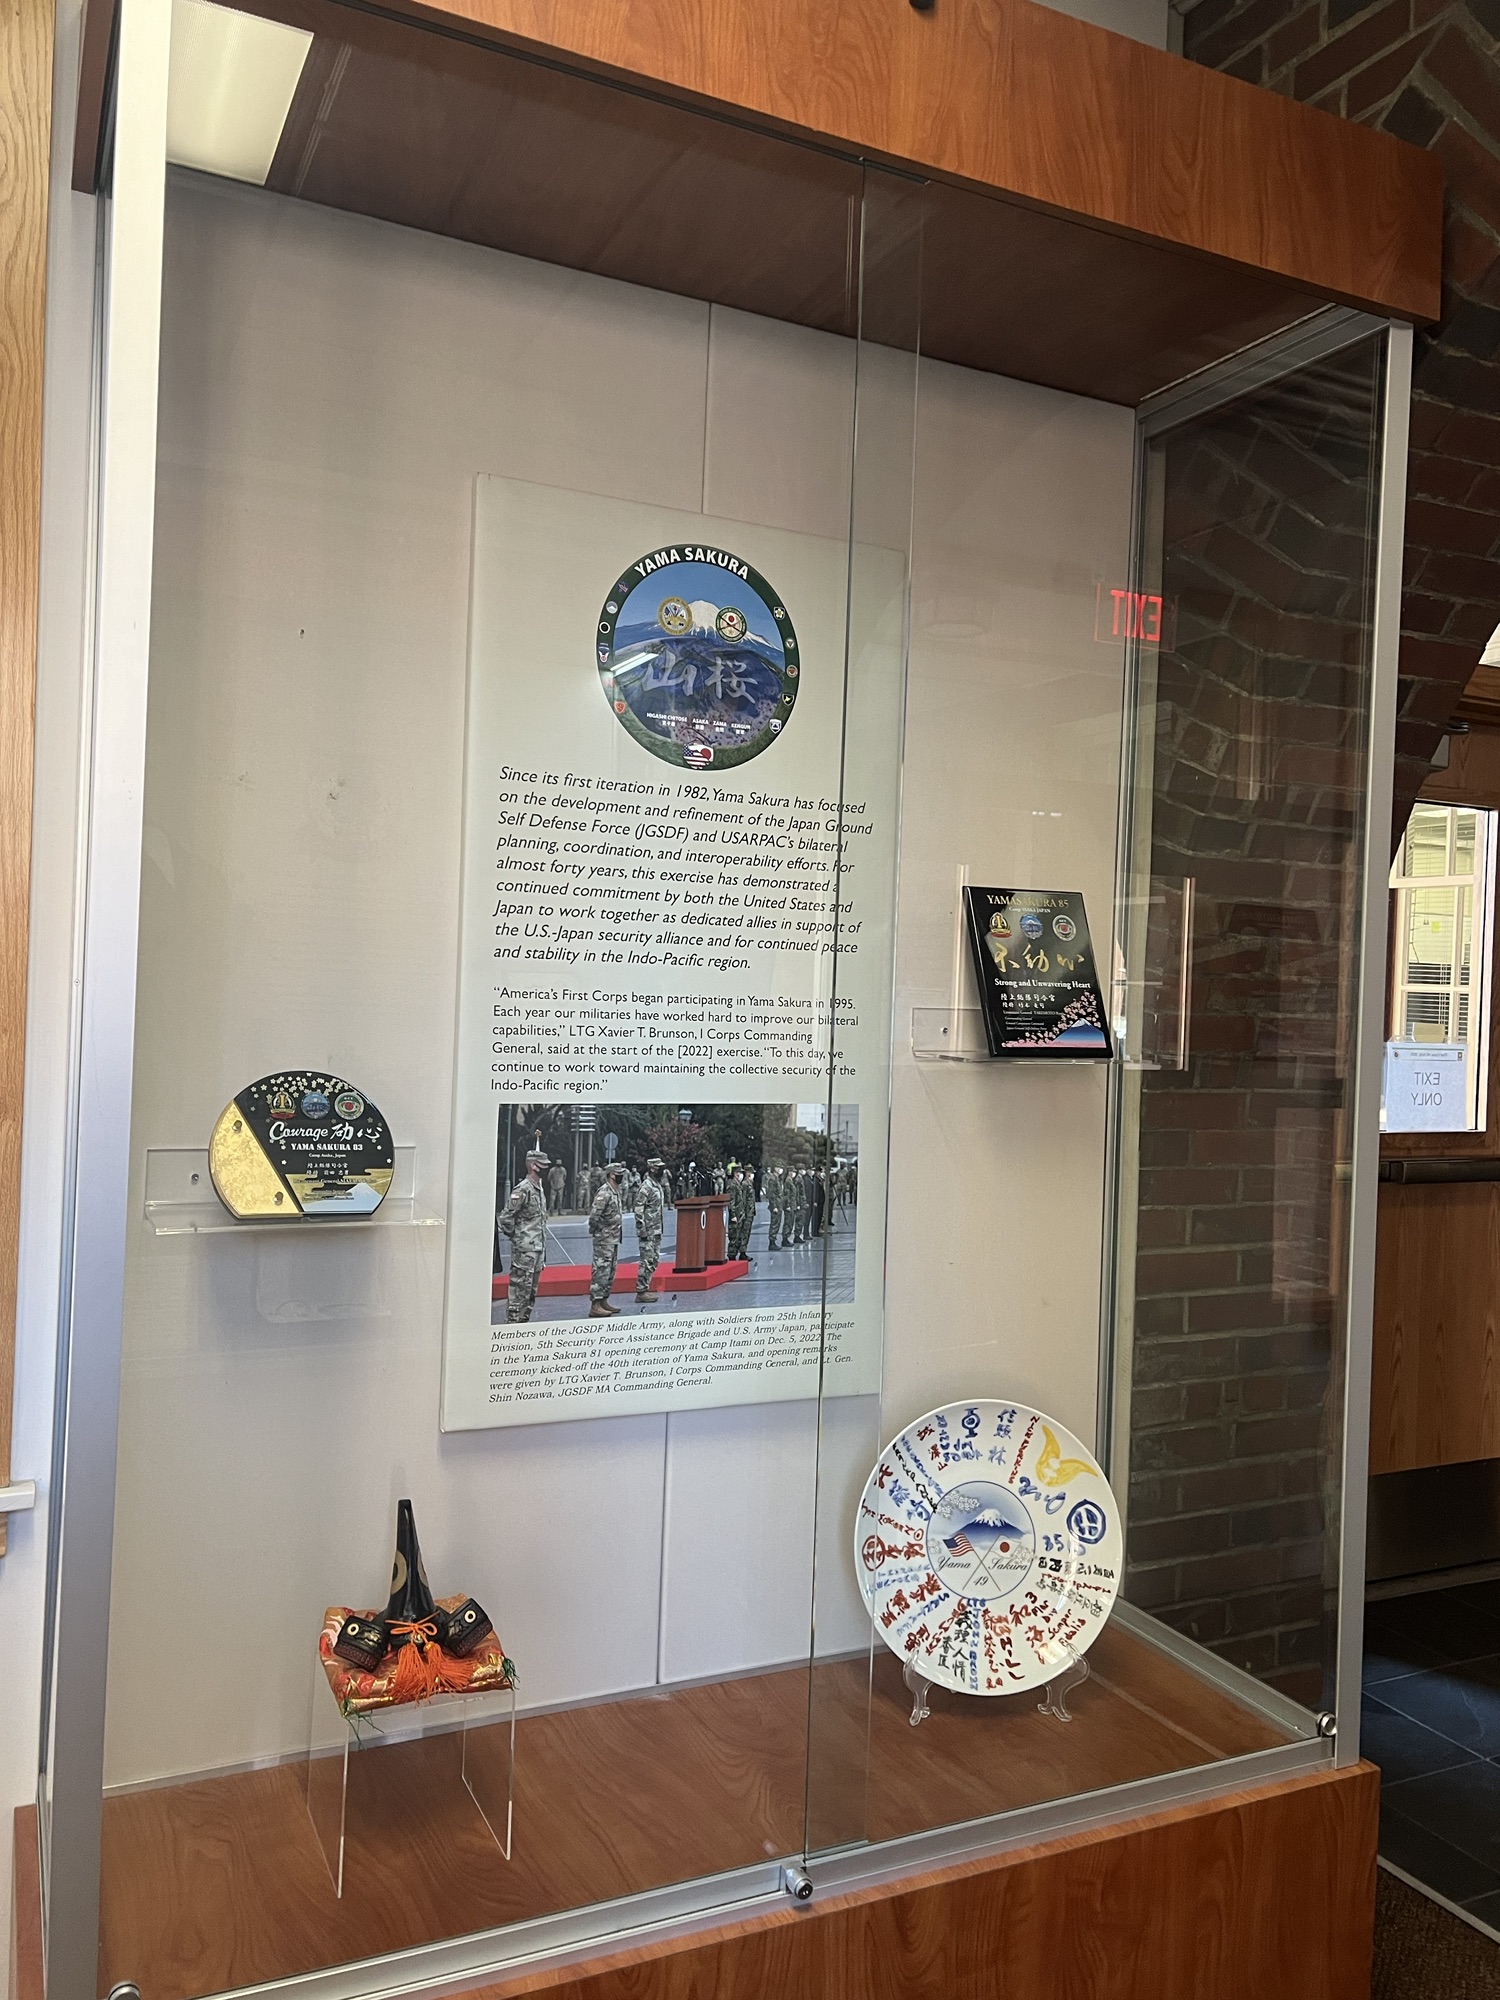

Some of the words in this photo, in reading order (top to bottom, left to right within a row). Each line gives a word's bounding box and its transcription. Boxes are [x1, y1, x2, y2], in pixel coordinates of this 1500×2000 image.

[634, 549, 681, 577] YAMA
[685, 548, 748, 579] SAKURA
[500, 766, 537, 782] Since
[542, 772, 559, 784] its
[564, 773, 592, 788] first
[596, 778, 654, 794] iteration
[659, 784, 670, 796] in
[677, 785, 709, 801] 1982,
[713, 788, 743, 803] Yama
[748, 792, 789, 807] Sakura
[794, 796, 814, 809] has
[818, 798, 866, 814] focused
[500, 793, 518, 803] on
[524, 792, 546, 805] the
[552, 794, 641, 814] development
[645, 805, 670, 817] and
[673, 807, 744, 824] refinement
[748, 813, 763, 825] of
[765, 814, 784, 827] the
[786, 816, 820, 832] Japan
[825, 819, 873, 835] Ground
[498, 811, 527, 825] Self
[529, 814, 586, 831] Defense
[592, 820, 630, 835] Force
[635, 823, 688, 844] (JGSDF)
[693, 830, 717, 842] and
[497, 834, 559, 854] planning,
[564, 842, 653, 860] coordination,
[658, 848, 682, 860] and
[686, 850, 783, 872] interoperability
[787, 857, 829, 871] efforts.
[1058, 899, 1069, 909] 85
[494, 945, 521, 958] and
[525, 946, 580, 964] stability
[584, 950, 596, 961] in
[602, 950, 623, 962] the
[628, 950, 704, 966] Indo-Pacific
[708, 956, 750, 971] region.
[994, 978, 1018, 988] Strong
[1019, 979, 1031, 987] and
[1032, 979, 1072, 990] Unwavering
[1071, 980, 1091, 988] Heart
[563, 989, 589, 1001] First
[592, 990, 628, 1006] Corps
[632, 992, 664, 1007] began
[668, 994, 733, 1009] participating
[737, 996, 746, 1006] in
[748, 996, 775, 1007] Yama
[778, 996, 813, 1009] Sakura
[816, 998, 825, 1009] in
[830, 998, 856, 1009] 1995.
[494, 1005, 521, 1017] Each
[525, 1010, 551, 1021] year
[555, 1010, 576, 1019] our
[580, 1008, 631, 1021] militaries
[635, 1009, 660, 1021] have
[663, 1011, 705, 1022] worked
[708, 1011, 733, 1023] hard
[736, 1015, 747, 1024] to
[751, 1013, 794, 1027] improve
[796, 1017, 815, 1025] our
[570, 1025, 595, 1037] LTG
[598, 1026, 635, 1038] Xavier
[637, 1027, 647, 1038] T.
[650, 1027, 698, 1041] Brunson,
[707, 1028, 741, 1043] Corps
[744, 1029, 813, 1045] Commanding
[492, 1079, 560, 1091] Indo-Pacific
[269, 1121, 328, 1141] Courage
[291, 1143, 316, 1151] YAMA
[316, 1143, 351, 1151] SAKURA
[491, 1342, 534, 1353] Division,
[537, 1340, 554, 1350] 5th
[556, 1338, 597, 1348] Security
[599, 1336, 625, 1345] Force
[626, 1333, 675, 1343] Assistance
[677, 1329, 712, 1341] Brigade
[714, 1328, 731, 1337] and
[734, 1327, 751, 1336] U.S.
[754, 1326, 778, 1336] Army
[778, 1324, 808, 1335] Japan,
[810, 1321, 855, 1332] paticipate
[492, 1330, 537, 1341] Members
[539, 1328, 551, 1337] of
[552, 1327, 567, 1337] the
[569, 1325, 605, 1335] JGSDF
[606, 1322, 637, 1333] Middle
[639, 1322, 666, 1331] Army,
[669, 1319, 695, 1329] along
[696, 1317, 715, 1326] with
[718, 1316, 753, 1325] Soldiers
[755, 1314, 775, 1323] from
[777, 1312, 797, 1321] 25th
[799, 1310, 833, 1321] Infanry
[490, 1368, 539, 1379] ceremony
[540, 1362, 590, 1375] kicked-off
[590, 1361, 606, 1371] the
[608, 1359, 630, 1369] 40th
[632, 1356, 671, 1367] iteration
[673, 1354, 683, 1364] of
[685, 1354, 709, 1363] Yama
[711, 1352, 745, 1361] Sakura,
[748, 1349, 766, 1358] and
[767, 1346, 802, 1359] opening
[937, 1556, 971, 1572] Yama
[988, 1558, 1028, 1571] Sakura
